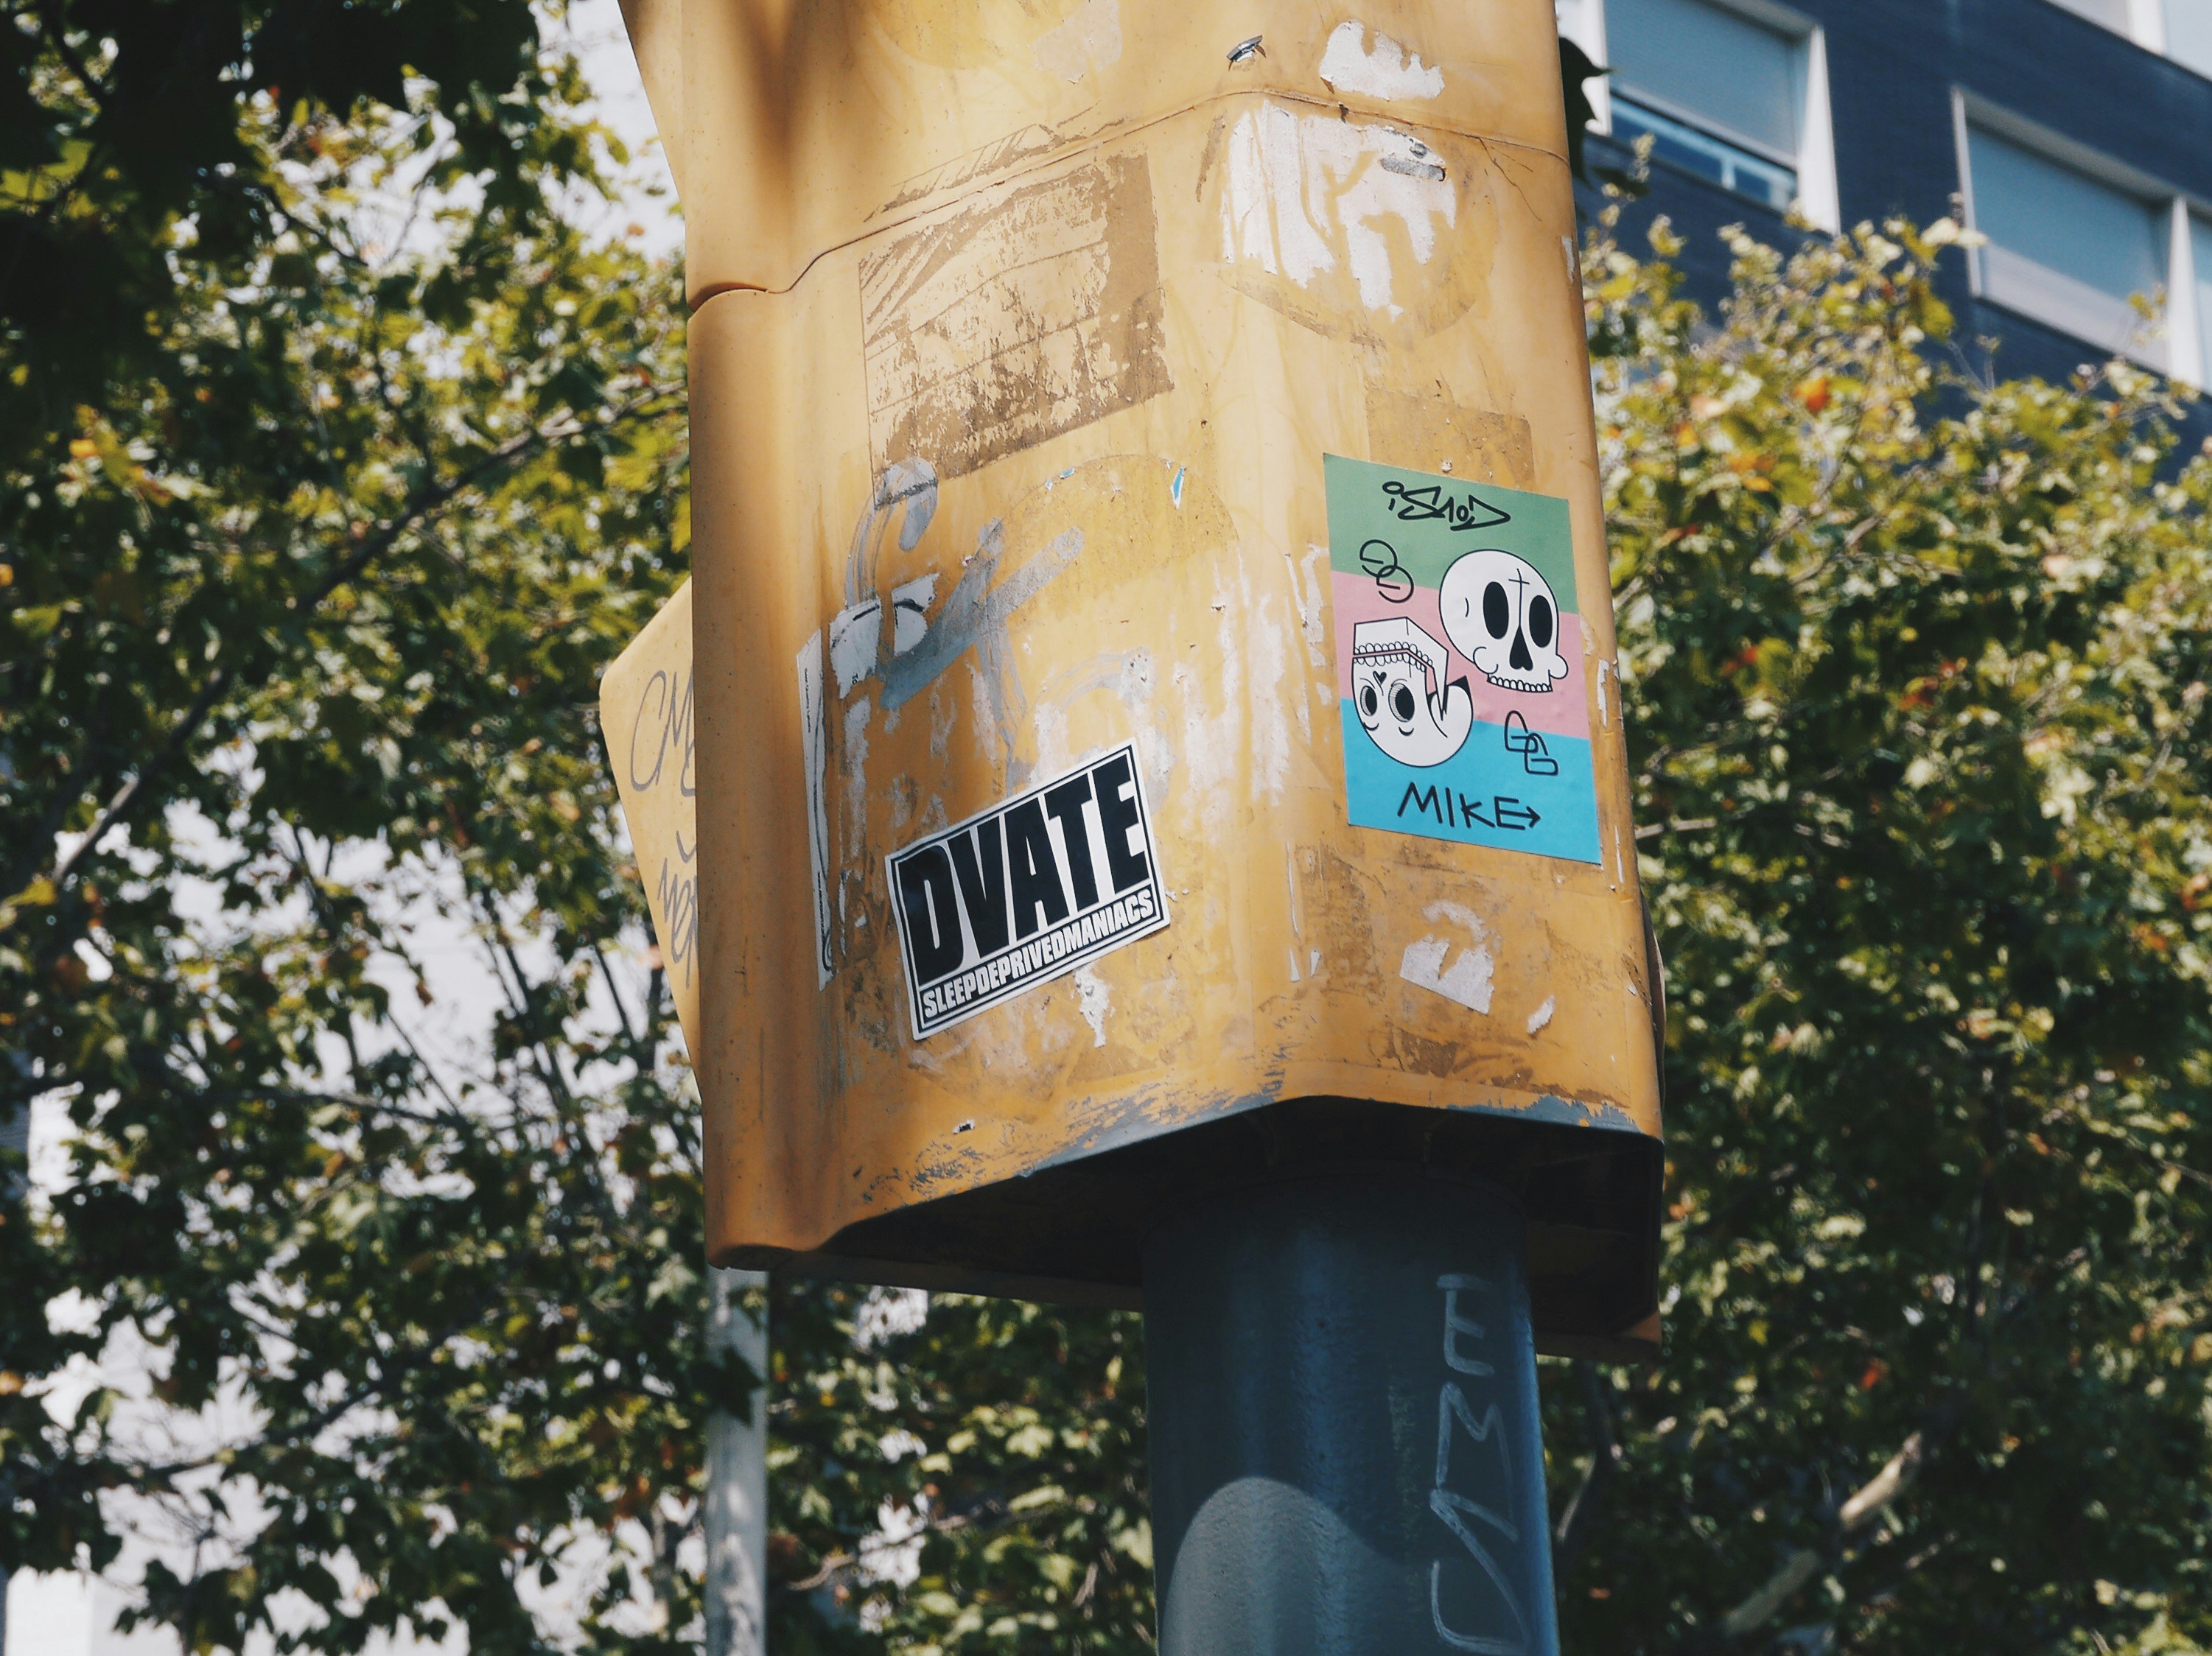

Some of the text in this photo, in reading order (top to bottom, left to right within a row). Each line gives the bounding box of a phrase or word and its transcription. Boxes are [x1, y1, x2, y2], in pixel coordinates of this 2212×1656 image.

[897, 754, 1150, 989] DVATE
[1397, 782, 1541, 830] MIKE
[923, 888, 1155, 1019] SLEEPDEPRIVEDMANIACS
